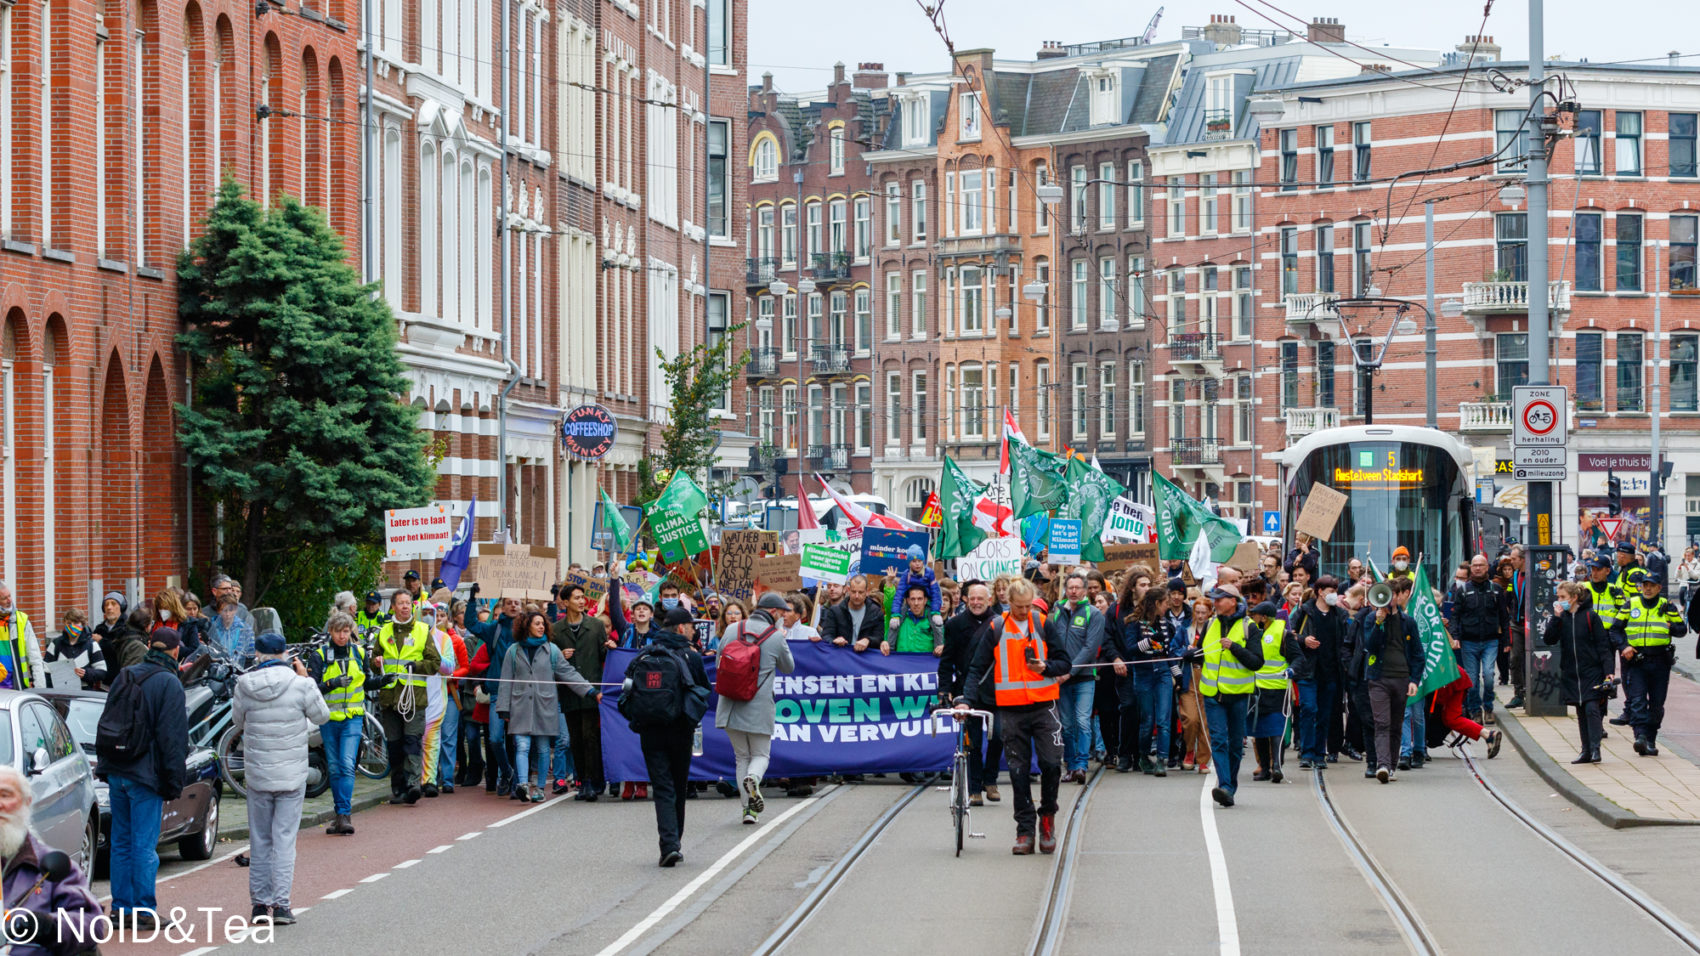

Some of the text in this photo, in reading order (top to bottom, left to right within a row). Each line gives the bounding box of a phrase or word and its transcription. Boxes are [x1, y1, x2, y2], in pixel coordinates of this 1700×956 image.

[569, 407, 611, 423] FUNKY
[564, 421, 614, 437] COFFEESHOP
[565, 435, 611, 457] MUNKEY
[1521, 436, 1560, 444] herhaling
[1387, 451, 1396, 467] 5
[1588, 457, 1651, 470] Voel je thuis bij
[1334, 467, 1423, 481] Amstelveen Stadshart
[390, 515, 446, 528] Later is te laat
[655, 514, 695, 534] CLIMAT
[1053, 523, 1067, 531] Hey
[1110, 511, 1144, 535] jong
[390, 531, 449, 543] voor het klimaat!
[659, 522, 700, 545] JUSTICE
[723, 531, 759, 544] WAT HEB
[722, 542, 757, 555] JE AAN
[1104, 548, 1157, 562] GNORANCE
[722, 553, 753, 569] GELD
[720, 568, 753, 581] ALS JE
[960, 559, 1021, 581] ON CHANGE
[567, 573, 588, 585] STOP
[718, 579, 737, 591] NIET
[773, 673, 939, 695] ENSEN EN KL
[774, 697, 881, 724] OVEN
[771, 723, 811, 742] AN
